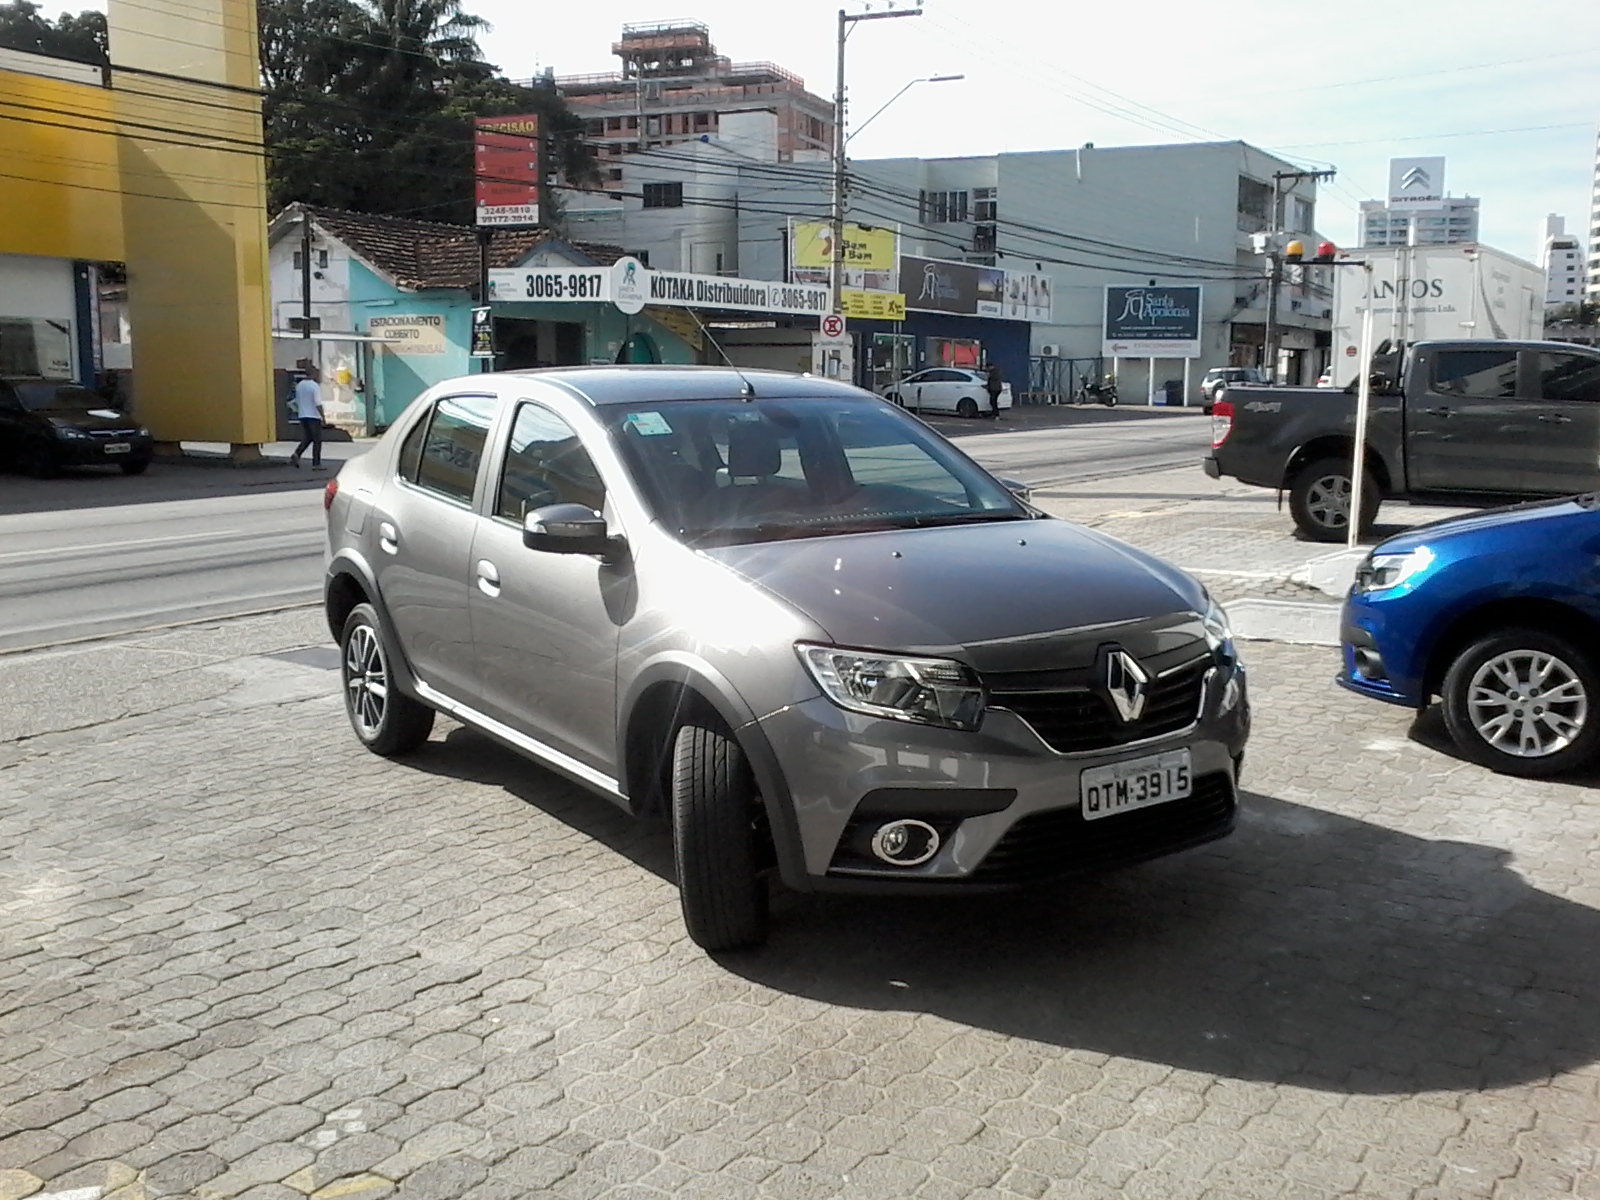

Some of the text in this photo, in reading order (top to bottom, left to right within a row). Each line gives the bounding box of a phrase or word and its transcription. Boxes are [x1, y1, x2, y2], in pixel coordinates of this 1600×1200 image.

[526, 274, 602, 298] 3065-9817
[650, 275, 695, 301] KOTAKA
[697, 279, 767, 307] Distribuidora
[781, 287, 827, 311] 3065-9817
[1145, 293, 1174, 309] Santa
[371, 316, 440, 327] ESTACIONAMENTO
[384, 329, 420, 339] COBERTO
